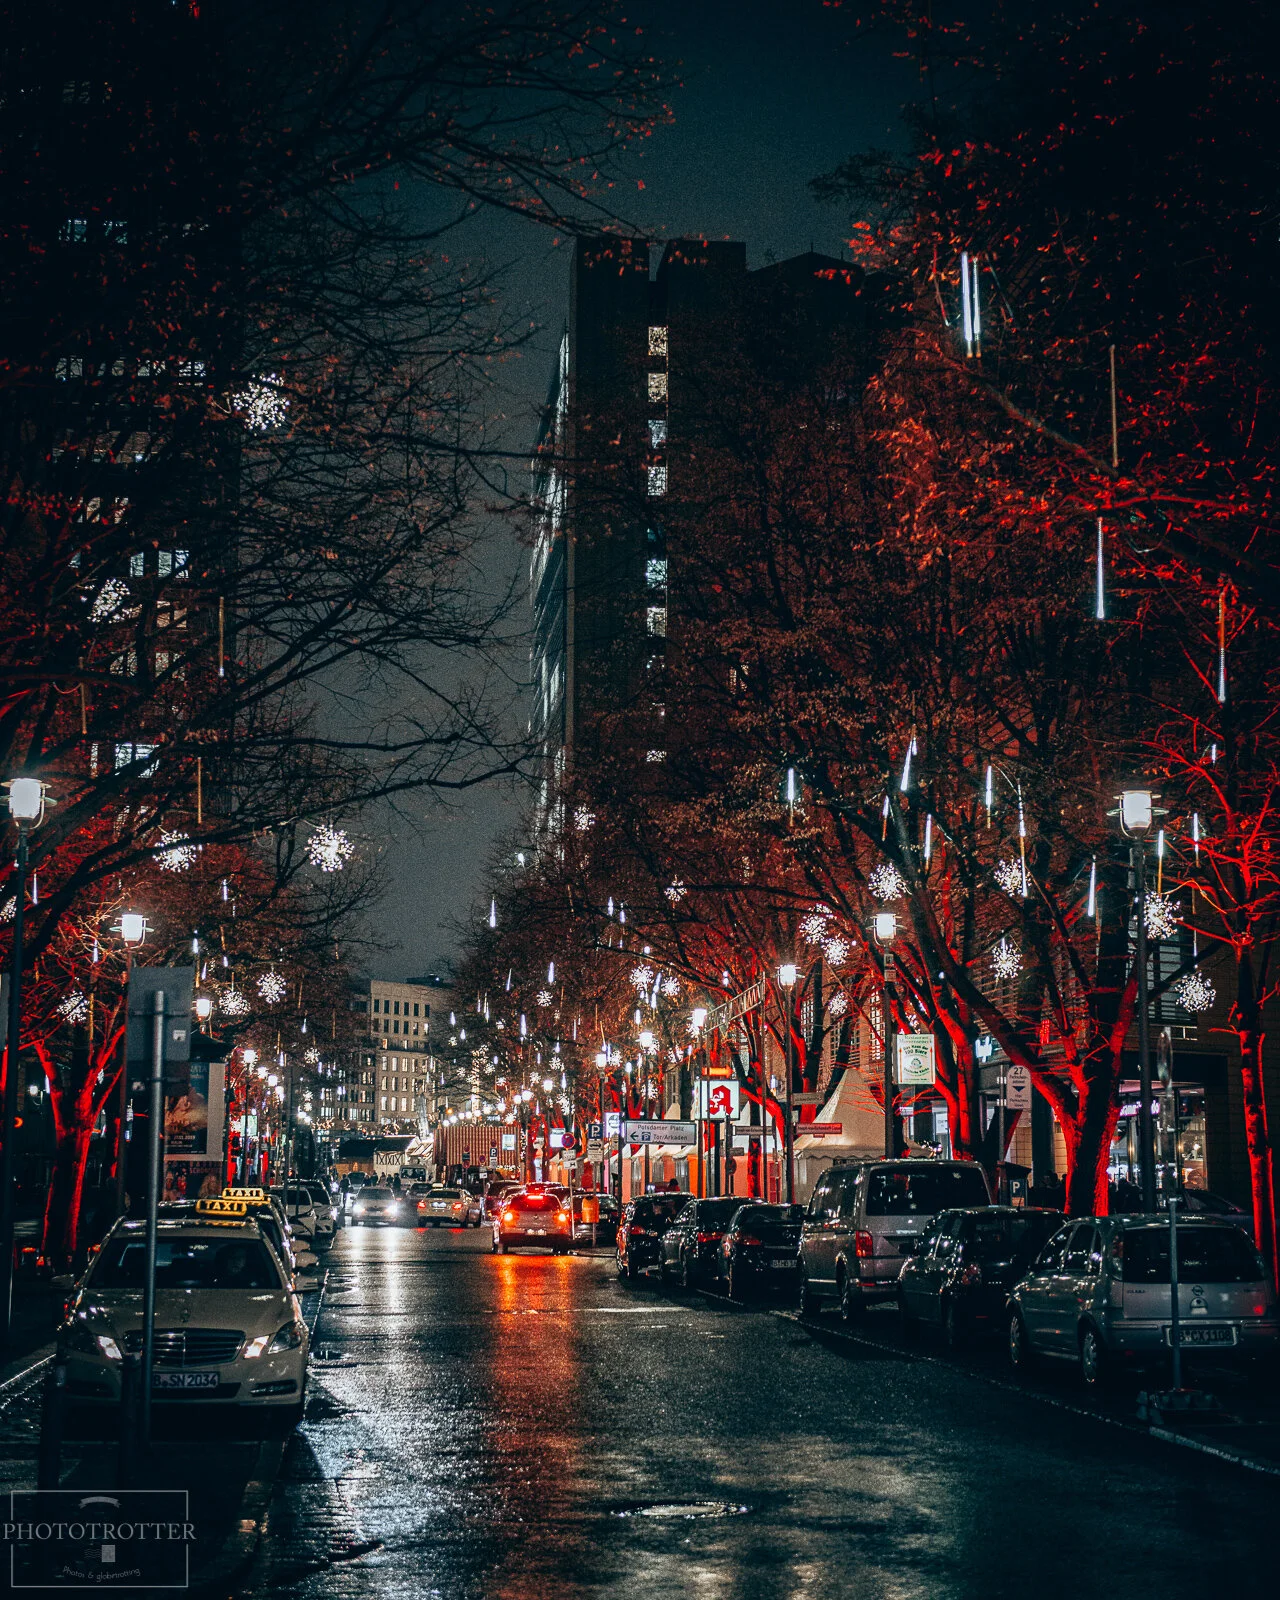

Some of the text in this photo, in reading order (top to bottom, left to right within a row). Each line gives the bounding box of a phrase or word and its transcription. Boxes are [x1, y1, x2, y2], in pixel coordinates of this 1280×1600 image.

[1013, 1066, 1024, 1075] 27
[669, 1124, 684, 1132] Platz
[1012, 1181, 1021, 1194] P
[230, 1189, 260, 1197] TAXI
[205, 1201, 239, 1211] TAXI
